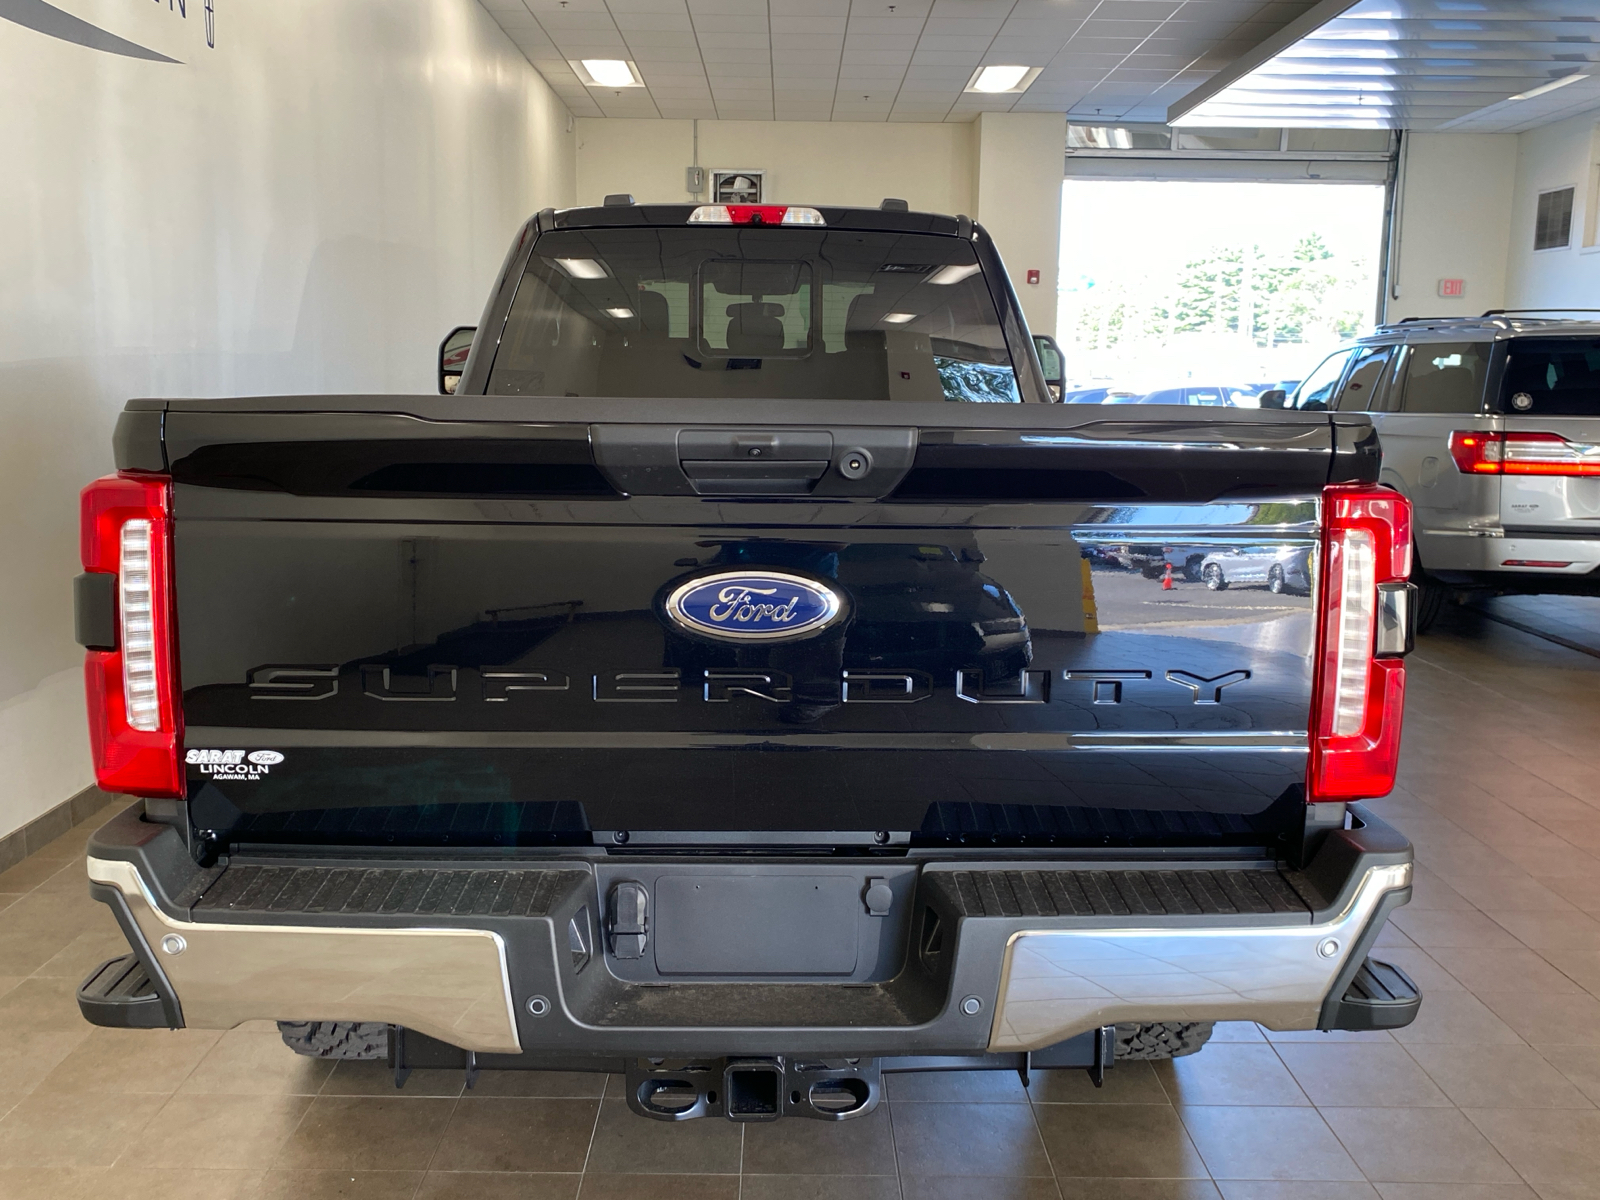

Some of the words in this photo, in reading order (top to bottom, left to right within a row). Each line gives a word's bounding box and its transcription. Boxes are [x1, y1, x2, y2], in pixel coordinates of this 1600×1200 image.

[1443, 279, 1463, 295] EXIT
[709, 586, 799, 622] Ford
[246, 664, 793, 702] SUPER
[843, 669, 1252, 704] DUTY
[185, 749, 246, 765] SARAT
[200, 764, 269, 774] LINCOLN
